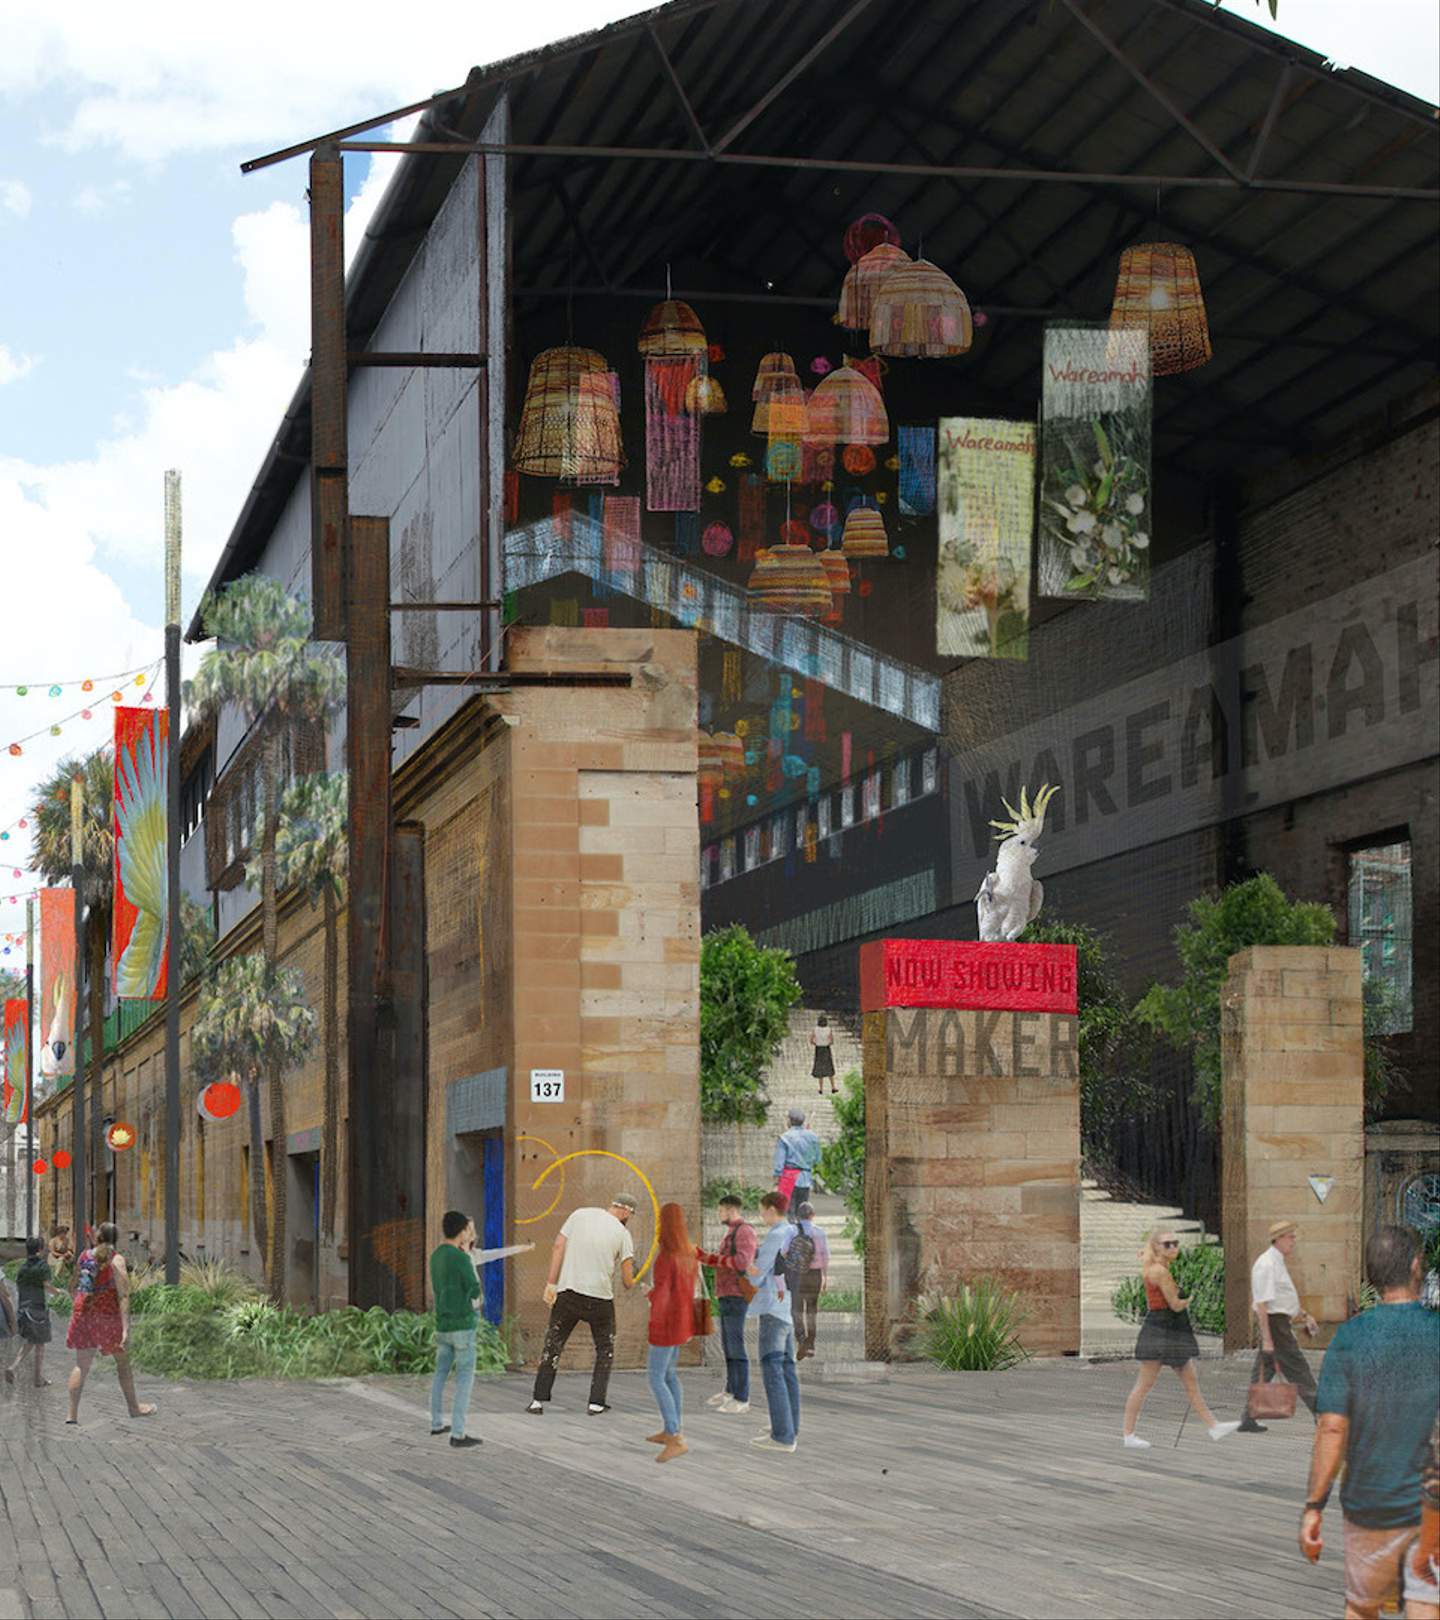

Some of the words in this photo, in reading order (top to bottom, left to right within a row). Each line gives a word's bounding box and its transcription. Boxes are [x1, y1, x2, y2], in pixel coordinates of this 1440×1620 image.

[1049, 360, 1148, 385] Wareamah
[946, 428, 1037, 456] Wareamah
[888, 958, 942, 991] NOW
[955, 960, 1072, 994] SHOWING
[886, 1007, 1079, 1078] MAKER
[534, 1082, 561, 1097] 137
